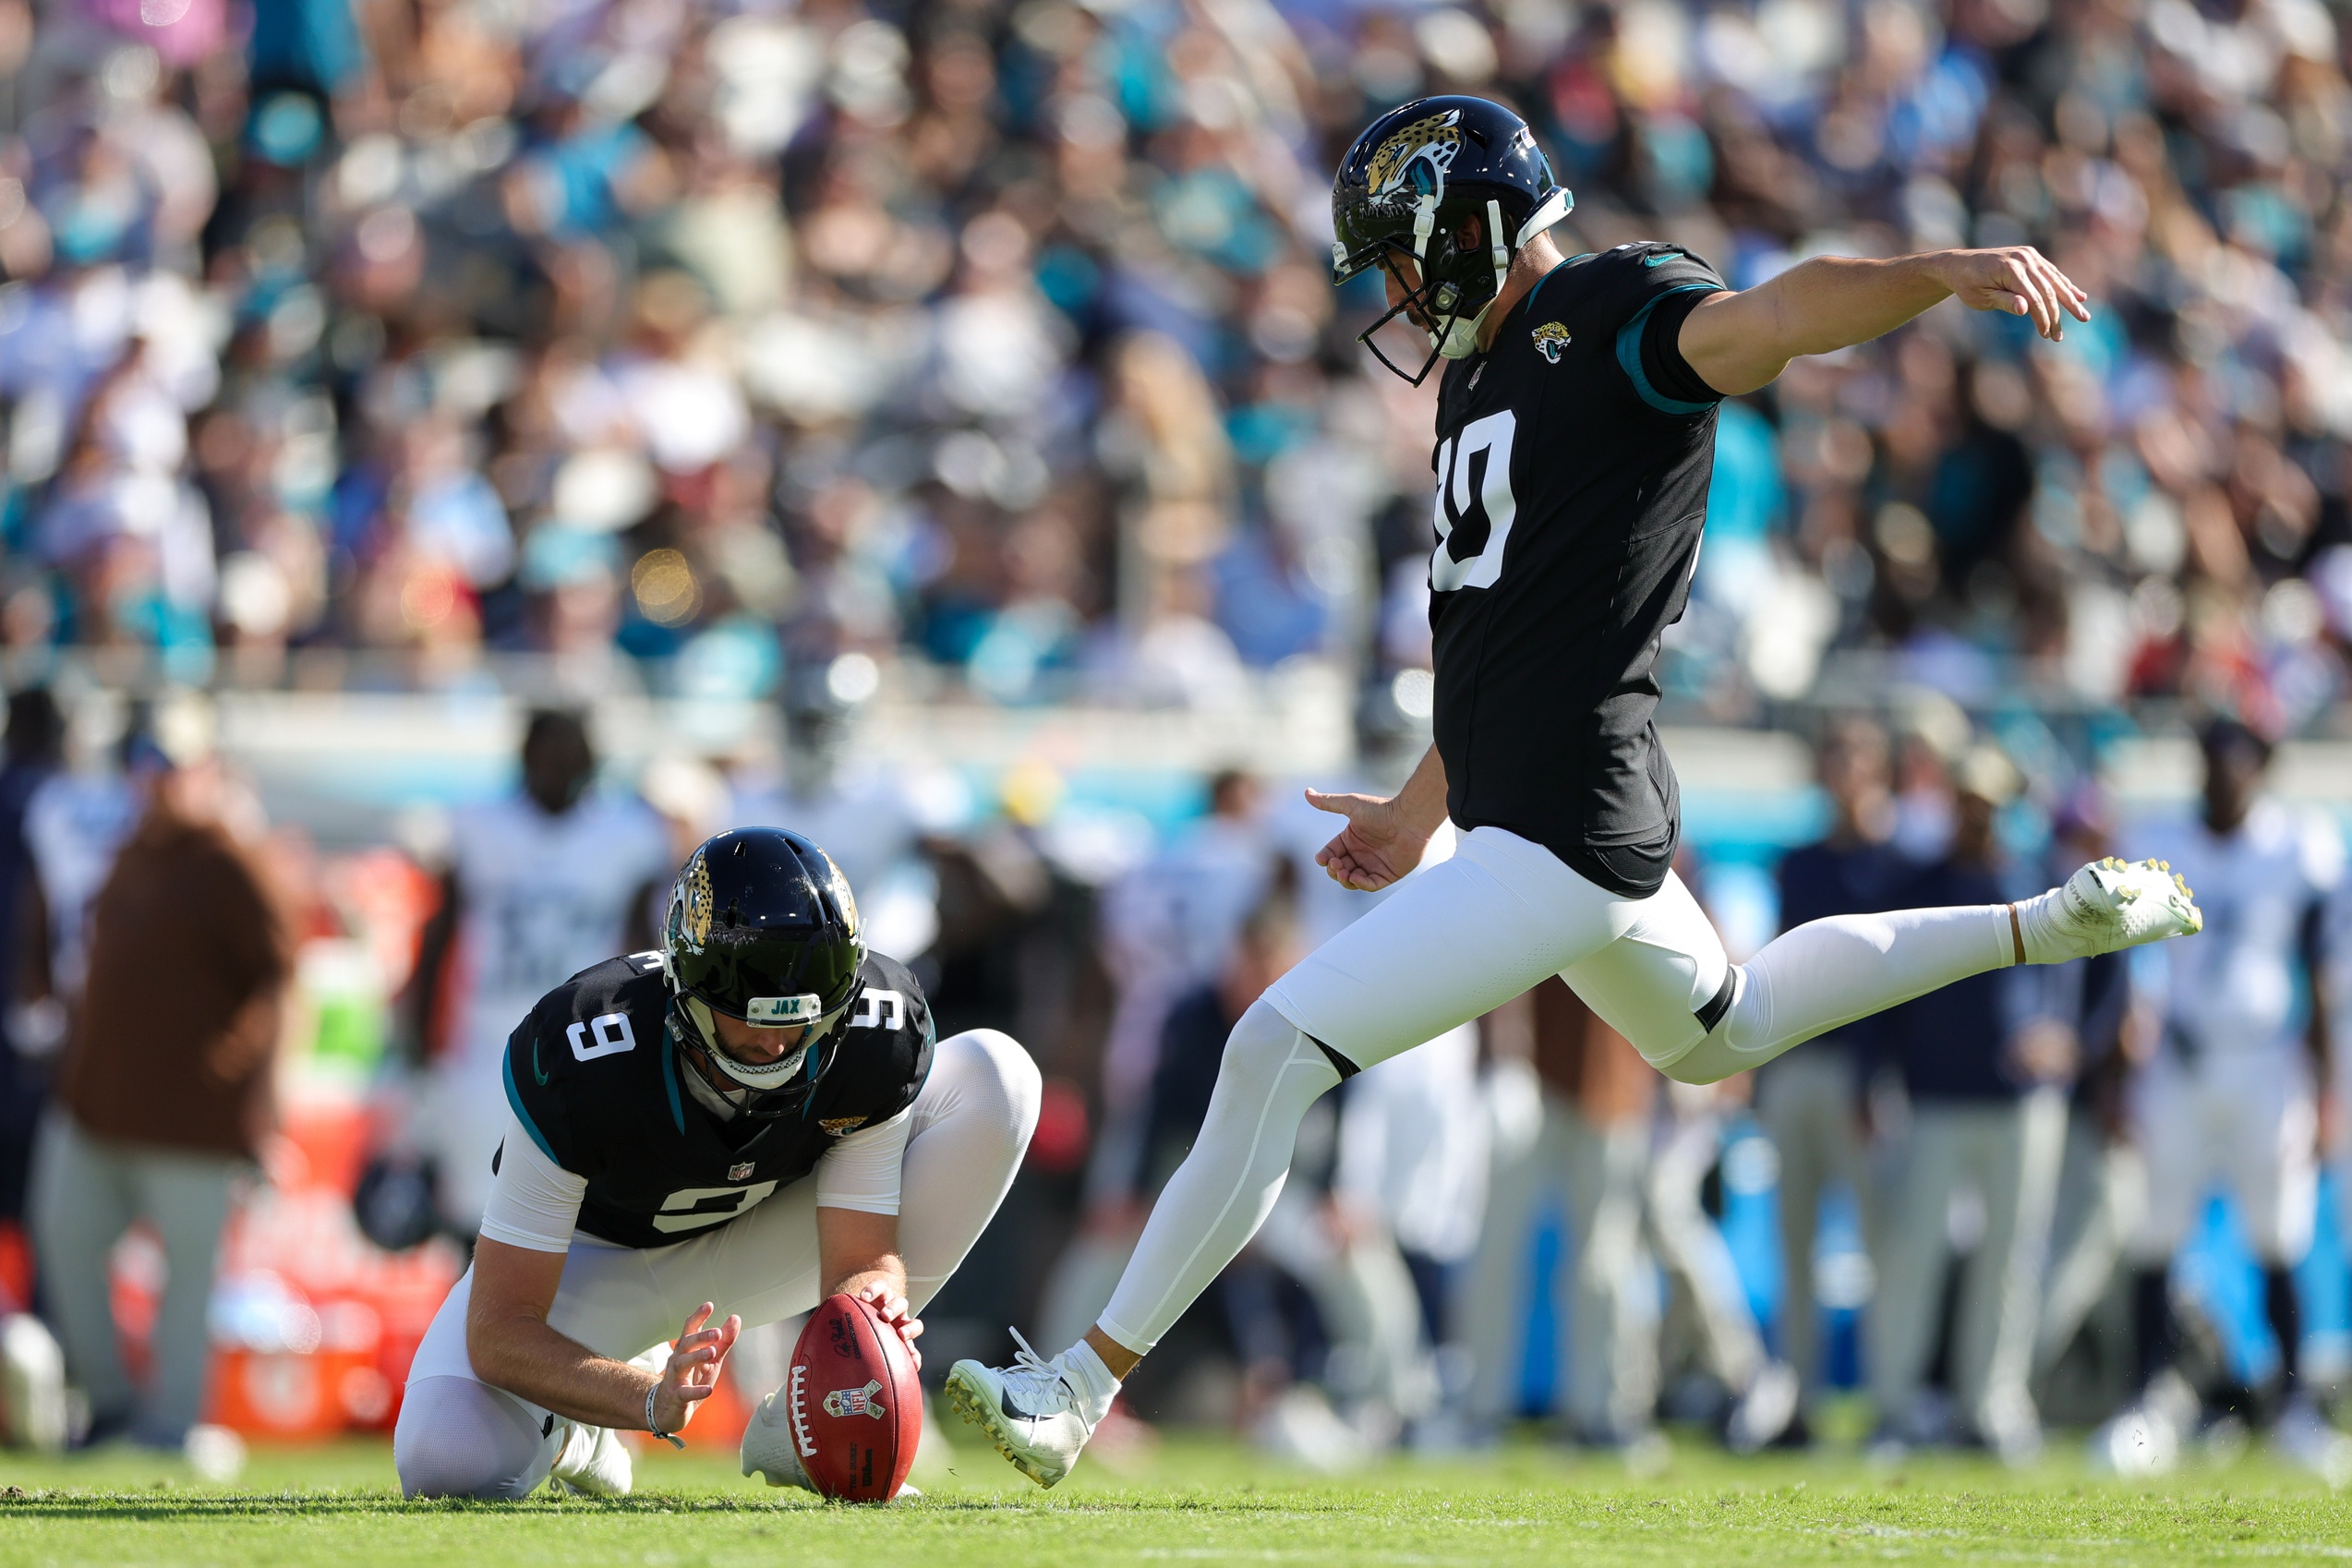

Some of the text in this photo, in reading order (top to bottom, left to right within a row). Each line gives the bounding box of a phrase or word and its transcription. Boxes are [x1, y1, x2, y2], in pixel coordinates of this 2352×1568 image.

[771, 999, 800, 1015] JAX
[565, 1011, 636, 1062] 9
[851, 1392, 866, 1413] NFL
[862, 1449, 874, 1488] Wilson
